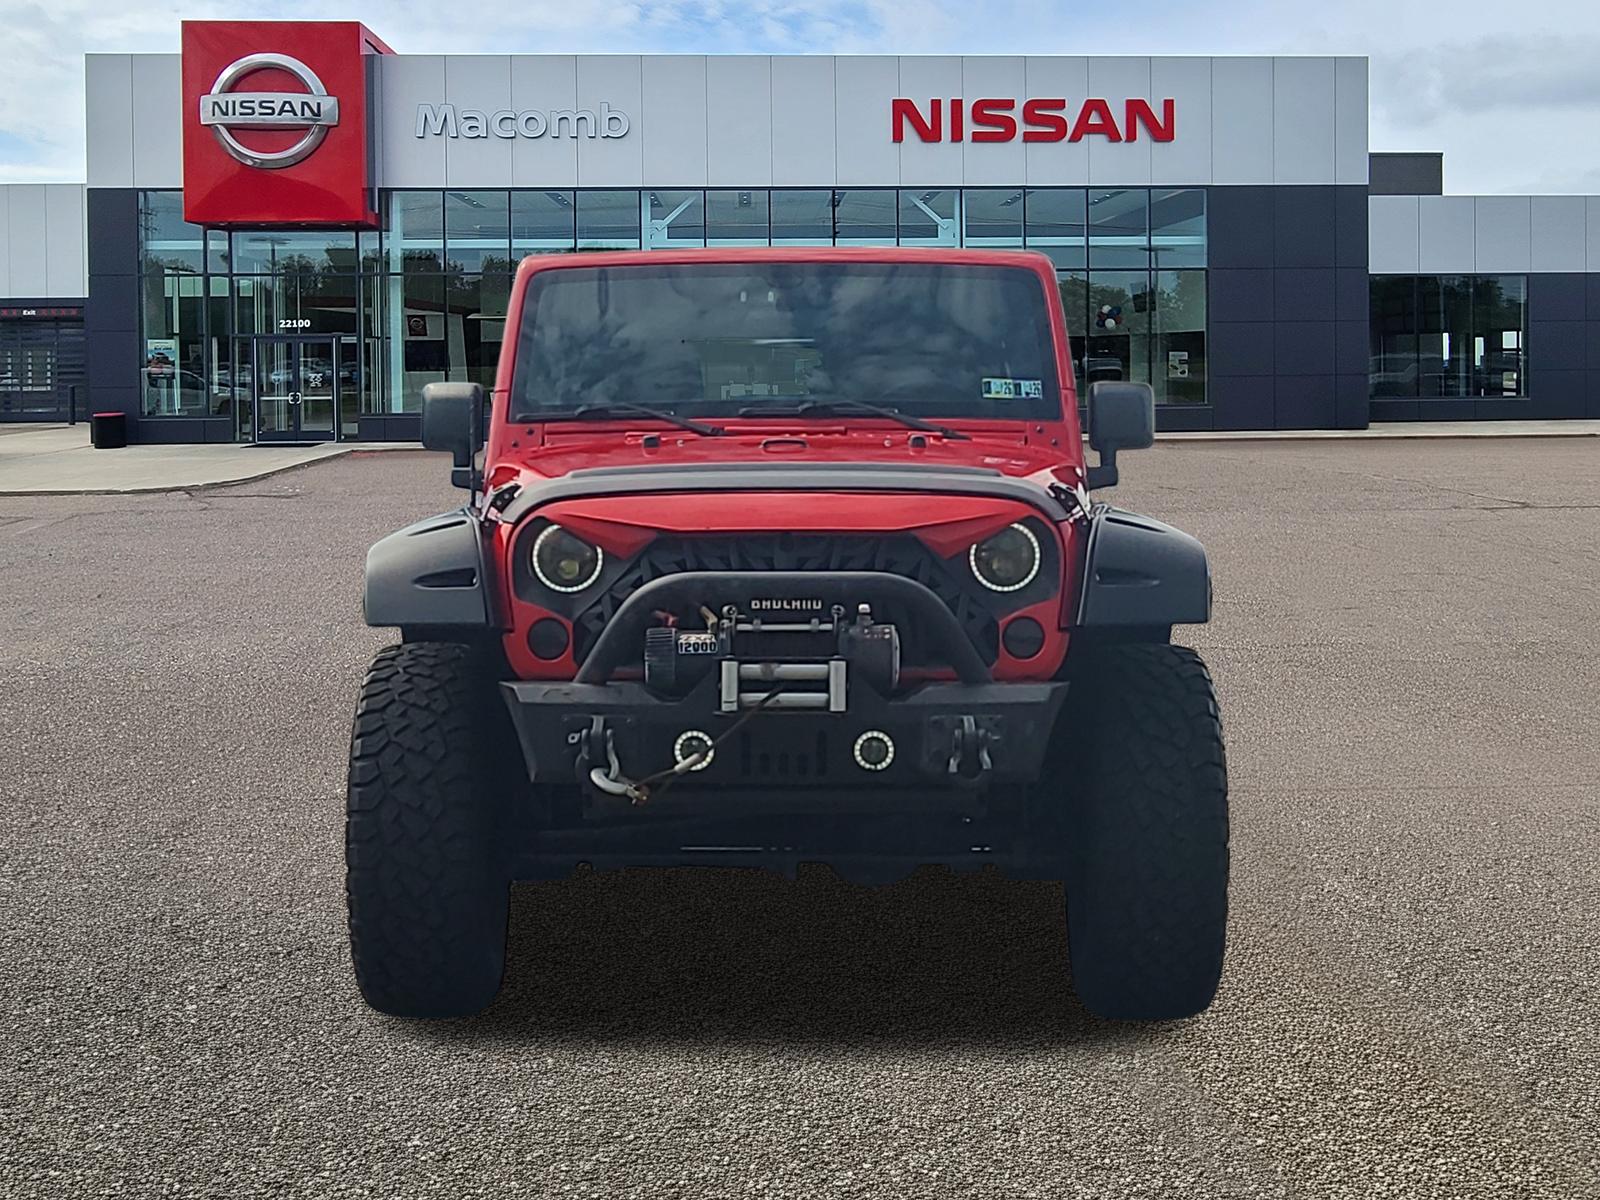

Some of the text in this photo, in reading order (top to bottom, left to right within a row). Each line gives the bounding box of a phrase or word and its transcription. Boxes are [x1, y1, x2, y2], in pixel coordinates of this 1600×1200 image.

[212, 100, 322, 117] NISSAN
[415, 102, 630, 138] Macomb
[892, 99, 1175, 142] NISSAN
[279, 319, 311, 328] 22100
[679, 641, 717, 653] 12000
